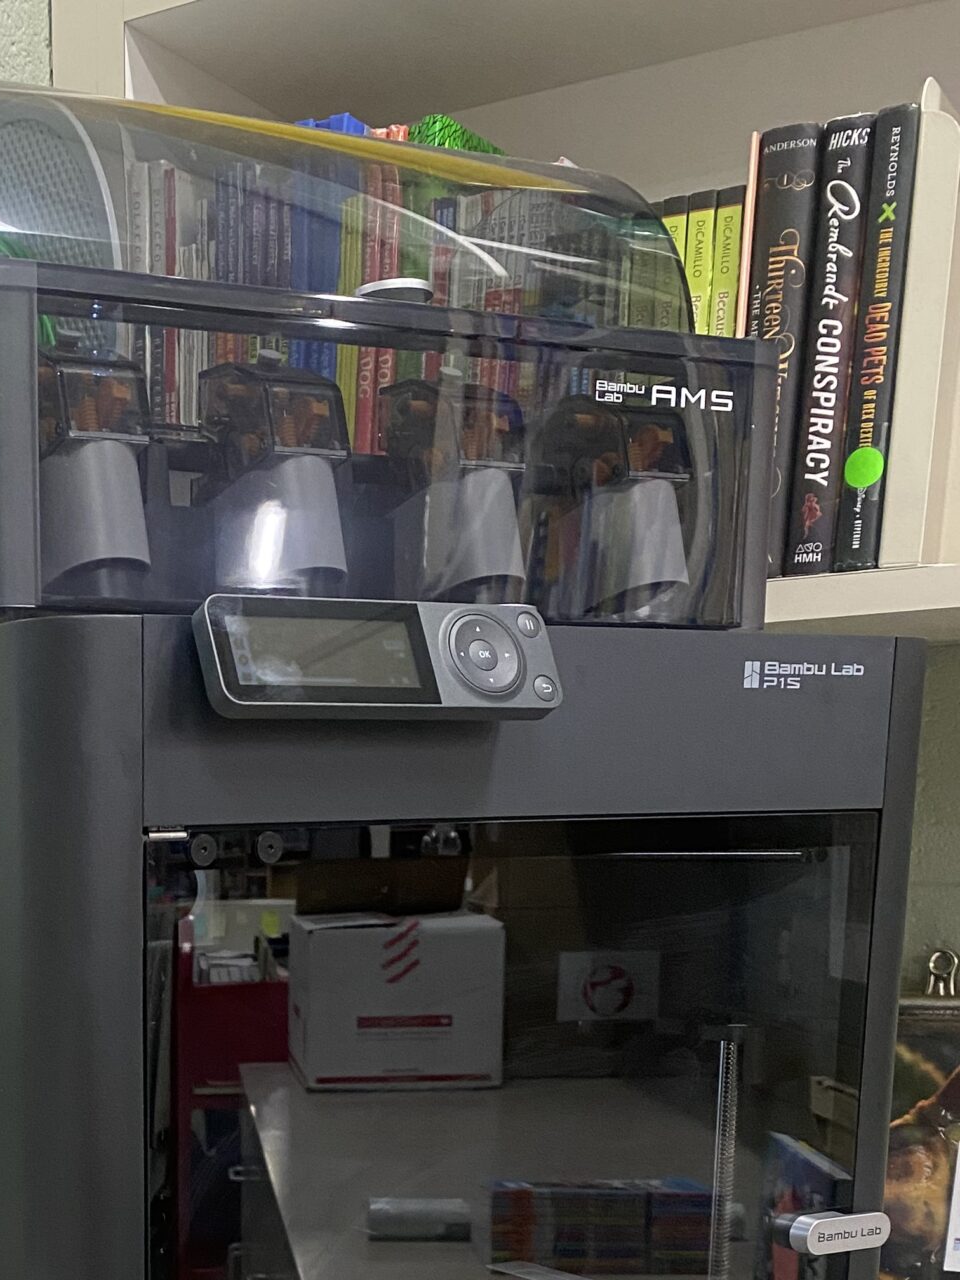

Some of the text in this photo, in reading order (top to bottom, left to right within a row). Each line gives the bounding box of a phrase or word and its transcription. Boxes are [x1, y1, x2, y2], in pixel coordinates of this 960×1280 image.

[763, 138, 817, 154] ANDERSON
[828, 127, 871, 150] HICKS
[885, 127, 901, 197] REYNOLDS
[693, 219, 706, 279] DiCAMILLO
[720, 215, 734, 275] DiCAMILLO
[822, 180, 861, 310] Rembrandt
[751, 291, 762, 315] THE
[859, 227, 893, 448] THE INCREDIBLY DEAD PETS OF REX DEXTE
[596, 380, 645, 394] Bambu
[596, 390, 623, 403] Lab
[651, 385, 734, 412] AMS
[804, 318, 843, 487] CONSPIRACY
[794, 552, 822, 563] HMH
[478, 649, 492, 660] OK
[764, 661, 865, 676] Bambu Lab
[763, 677, 801, 689] P1S
[817, 1226, 882, 1243] Bambu Lab
